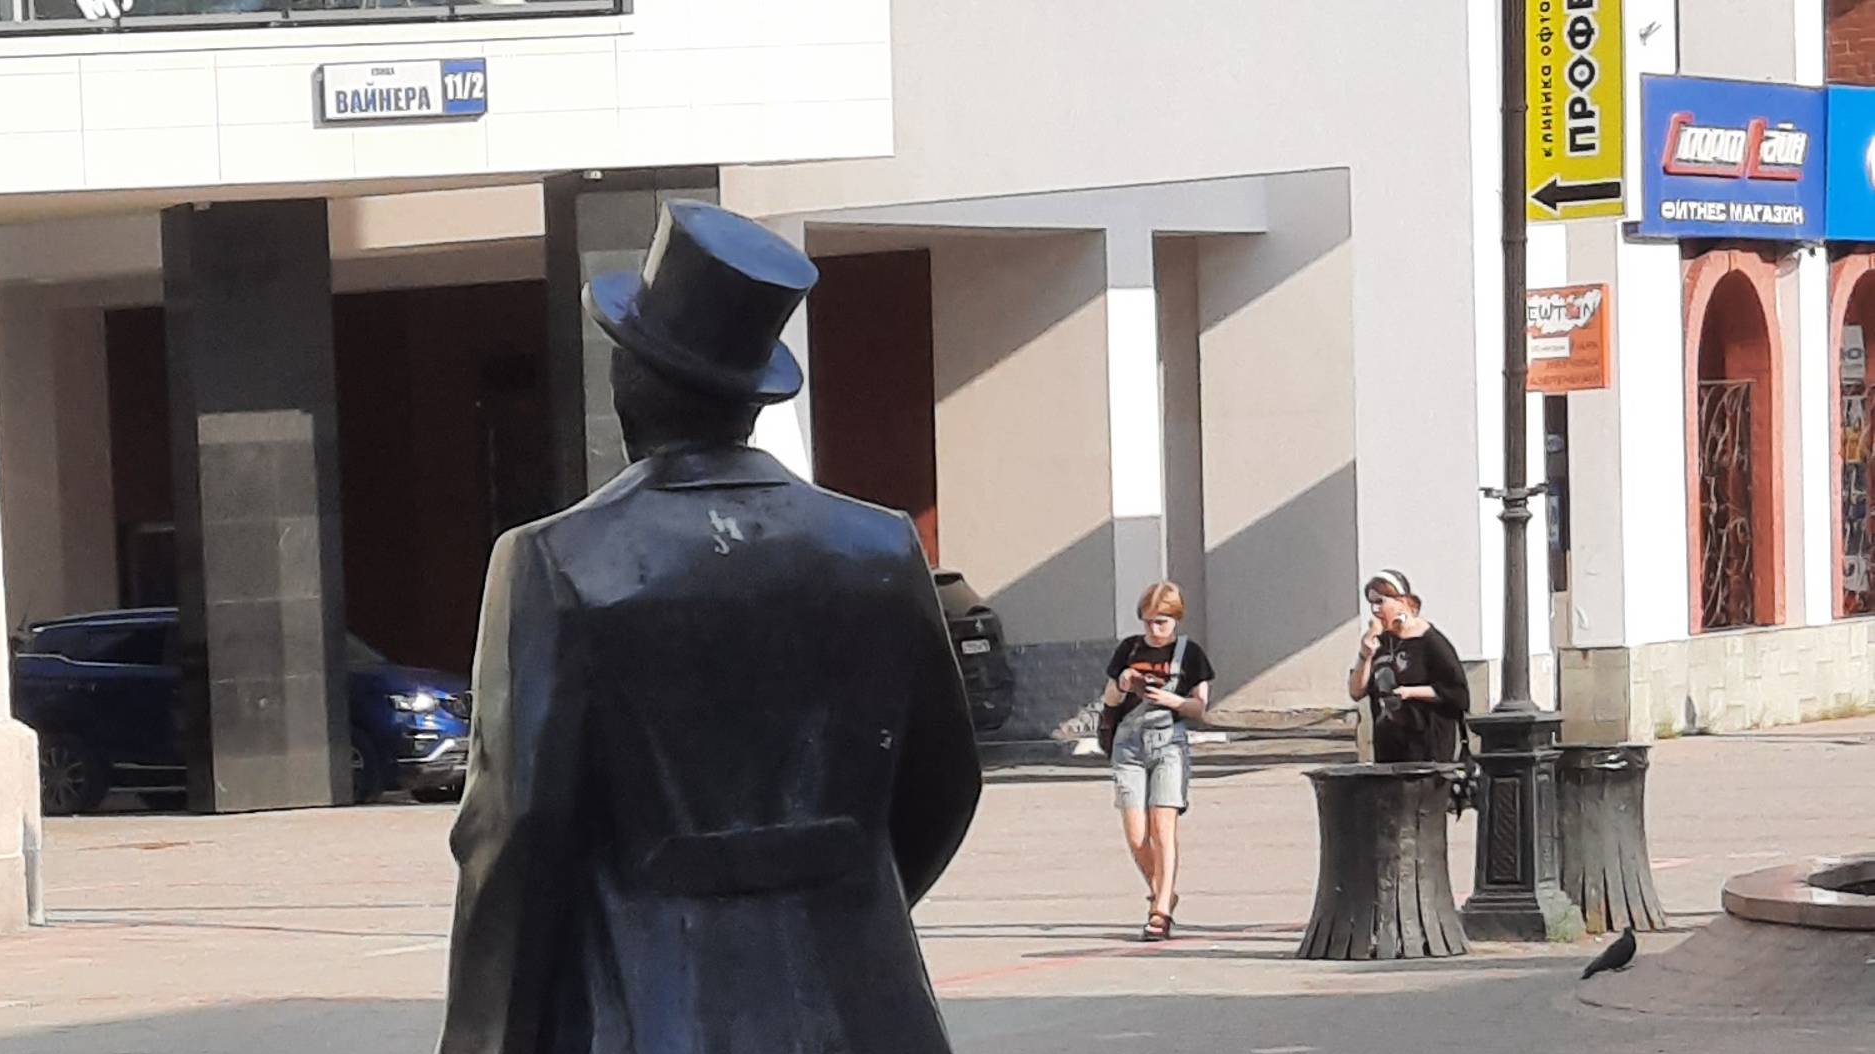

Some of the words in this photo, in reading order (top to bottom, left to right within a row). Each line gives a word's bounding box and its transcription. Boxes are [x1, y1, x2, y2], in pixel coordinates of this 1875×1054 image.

[335, 82, 431, 113] ВАЙНЕРА
[444, 72, 485, 100] 11/2
[1660, 199, 1727, 222] ФИТНЕС
[1729, 203, 1804, 225] МАГАЗИН
[1527, 302, 1597, 321] EWTON
